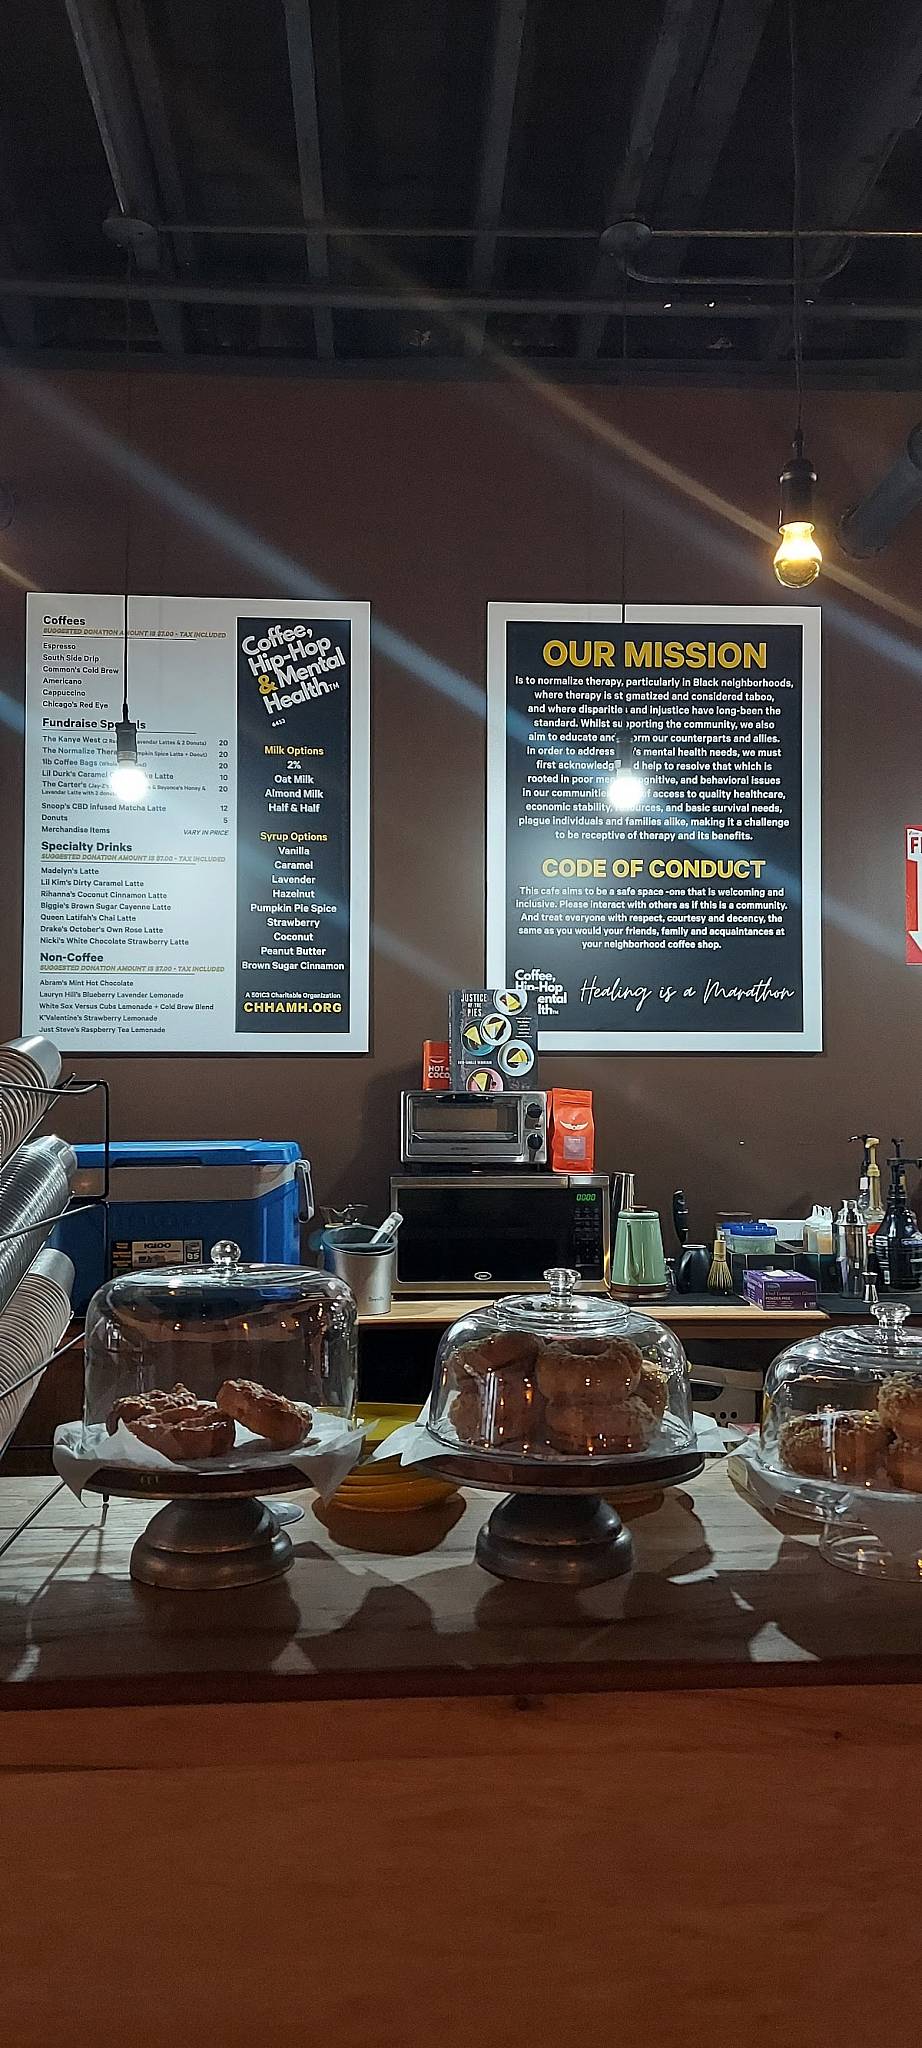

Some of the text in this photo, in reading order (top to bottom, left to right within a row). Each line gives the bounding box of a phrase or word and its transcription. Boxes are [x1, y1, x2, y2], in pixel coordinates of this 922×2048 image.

[43, 616, 86, 625] Coffees
[242, 625, 312, 655] Coffee,
[248, 638, 331, 676] Hip-Hop
[543, 640, 766, 668] OUR MISSION
[258, 647, 346, 694] & Mental
[516, 676, 523, 684] Is
[526, 676, 535, 685] to
[538, 676, 583, 686] normalize
[586, 677, 624, 687] therapy,
[626, 678, 680, 688] particularly
[693, 678, 718, 687] Black
[721, 678, 794, 688] neighborhoods,
[42, 701, 78, 709] Chicago's
[42, 718, 97, 728] Fundraise
[265, 746, 324, 756] Milk Options
[287, 761, 301, 769] 2%
[274, 775, 314, 784] Oat Milk
[265, 789, 324, 798] Almond Milk
[269, 803, 320, 812] Half & Half
[519, 816, 550, 826] plague
[553, 816, 603, 825] individuals
[606, 817, 622, 826] and
[664, 818, 688, 827] alike,
[691, 818, 725, 827] making
[744, 819, 789, 828] challenge
[260, 832, 328, 842] Syrup Options
[41, 842, 132, 852] Specialty Drinks
[278, 846, 310, 855] Vanilla
[274, 861, 313, 870] Caramel
[542, 859, 766, 878] CODE OF CONDUCT
[272, 875, 316, 884] Lavender
[273, 890, 315, 898] Hazelnut
[251, 904, 336, 914] Pumpkin Pie Spice
[267, 918, 320, 928] Strawberry
[274, 932, 313, 940] Coconut
[582, 940, 721, 950] your neighborhood coffee shop.
[261, 947, 326, 956] Peanut Butter
[40, 953, 103, 962] Non-Coffee
[242, 962, 344, 971] Brown Sugar Cinnamon
[515, 969, 556, 982] Coffee,
[461, 993, 487, 1002] JUSTICE
[538, 994, 567, 1003] ental
[580, 976, 652, 1012] Healing
[660, 985, 677, 1003] is
[683, 986, 696, 998] a
[703, 977, 794, 1004] Marathon
[244, 1002, 342, 1013] CHHAMH.ORG
[468, 1008, 482, 1017] PIES
